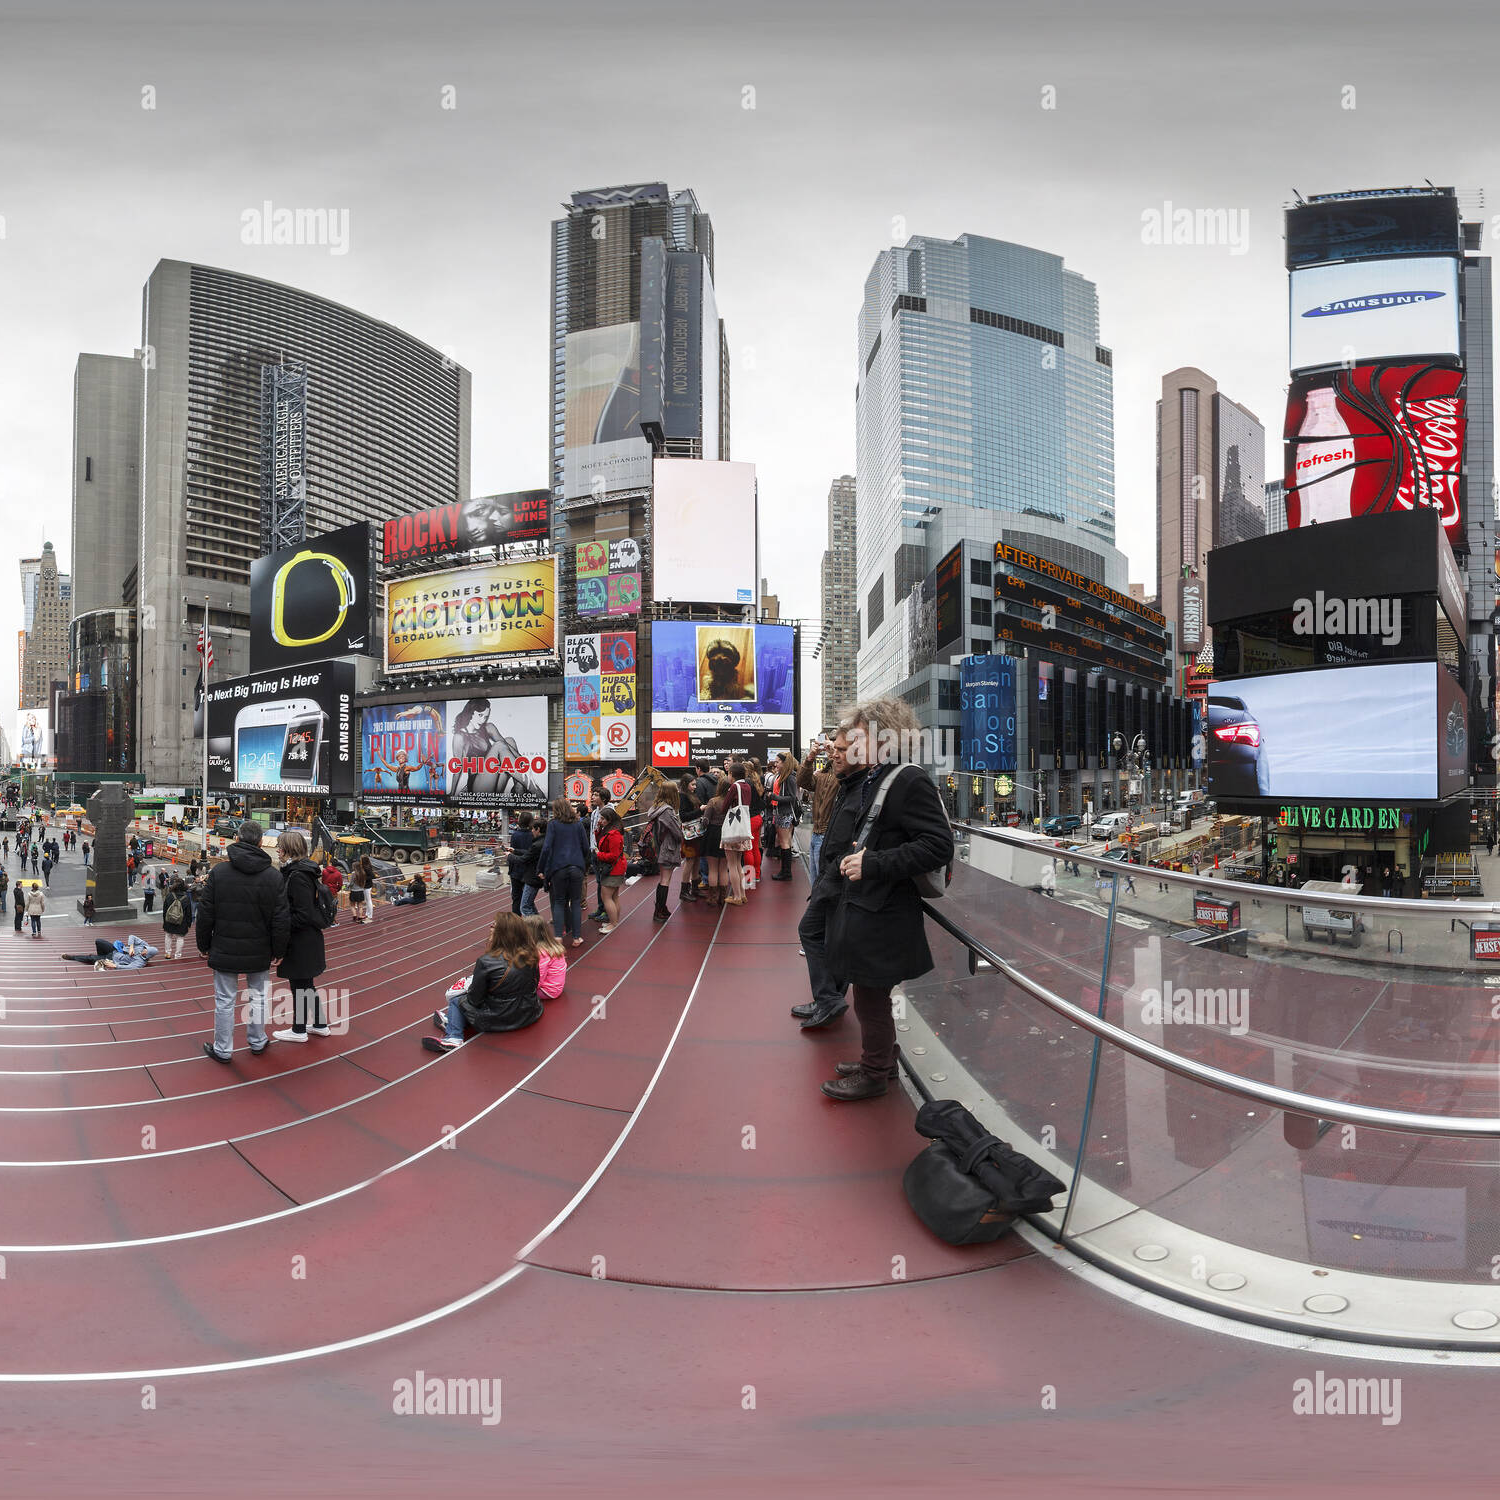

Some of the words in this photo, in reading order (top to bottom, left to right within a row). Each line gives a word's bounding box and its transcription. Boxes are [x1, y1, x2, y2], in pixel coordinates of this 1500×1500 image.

[1320, 295, 1426, 312] SAMSUNG
[275, 400, 289, 432] EAGLE
[289, 411, 303, 479] OUTFITTERS
[275, 433, 289, 497] AMERICAN
[609, 455, 648, 465] CHANDON
[1297, 449, 1353, 470] refresh
[513, 499, 547, 512] LOVE
[513, 510, 547, 523] WINS
[384, 504, 463, 556] ROCKY
[384, 541, 458, 564] BROADWAY
[995, 542, 1037, 569] AFTER
[1040, 559, 1085, 590] PRIVATE
[1086, 577, 1110, 602] JOBS
[395, 586, 482, 607] EVERYONE'S
[490, 578, 545, 592] MUSIC.
[391, 590, 545, 634] MOTOWN
[1183, 586, 1200, 644] HERSHEY'S
[394, 626, 472, 644] BROADWAY'S
[479, 619, 545, 634] MUSICAL.
[567, 637, 595, 646] BLACK
[214, 688, 233, 700] Next
[234, 684, 249, 698] Big
[251, 680, 277, 694] Thing
[280, 677, 290, 689] Is
[567, 677, 589, 685] PINK
[602, 675, 635, 684] PURPLE
[980, 680, 999, 688] Stanley
[602, 695, 626, 703] HAZE
[339, 694, 350, 762] SAMSUNG
[373, 722, 383, 732] 2013
[384, 721, 396, 731] TONY
[396, 720, 412, 730] AWARD
[413, 719, 433, 730] WINNER!
[731, 715, 763, 724] AERVA
[289, 731, 311, 744] 12:45
[368, 732, 440, 764] PIPPIN
[655, 741, 687, 757] CNN
[241, 752, 276, 770] 12:45
[448, 756, 547, 774] CHICAGO
[230, 782, 261, 790] AMERICAN
[283, 784, 329, 794] OUTFITTERS
[412, 807, 442, 816] GRAND
[460, 810, 488, 818] SLAM
[1278, 806, 1321, 828] OLIVE
[1324, 807, 1401, 829] GARDEN
[1196, 909, 1214, 920] JERSEY
[1215, 911, 1229, 921] BOYS
